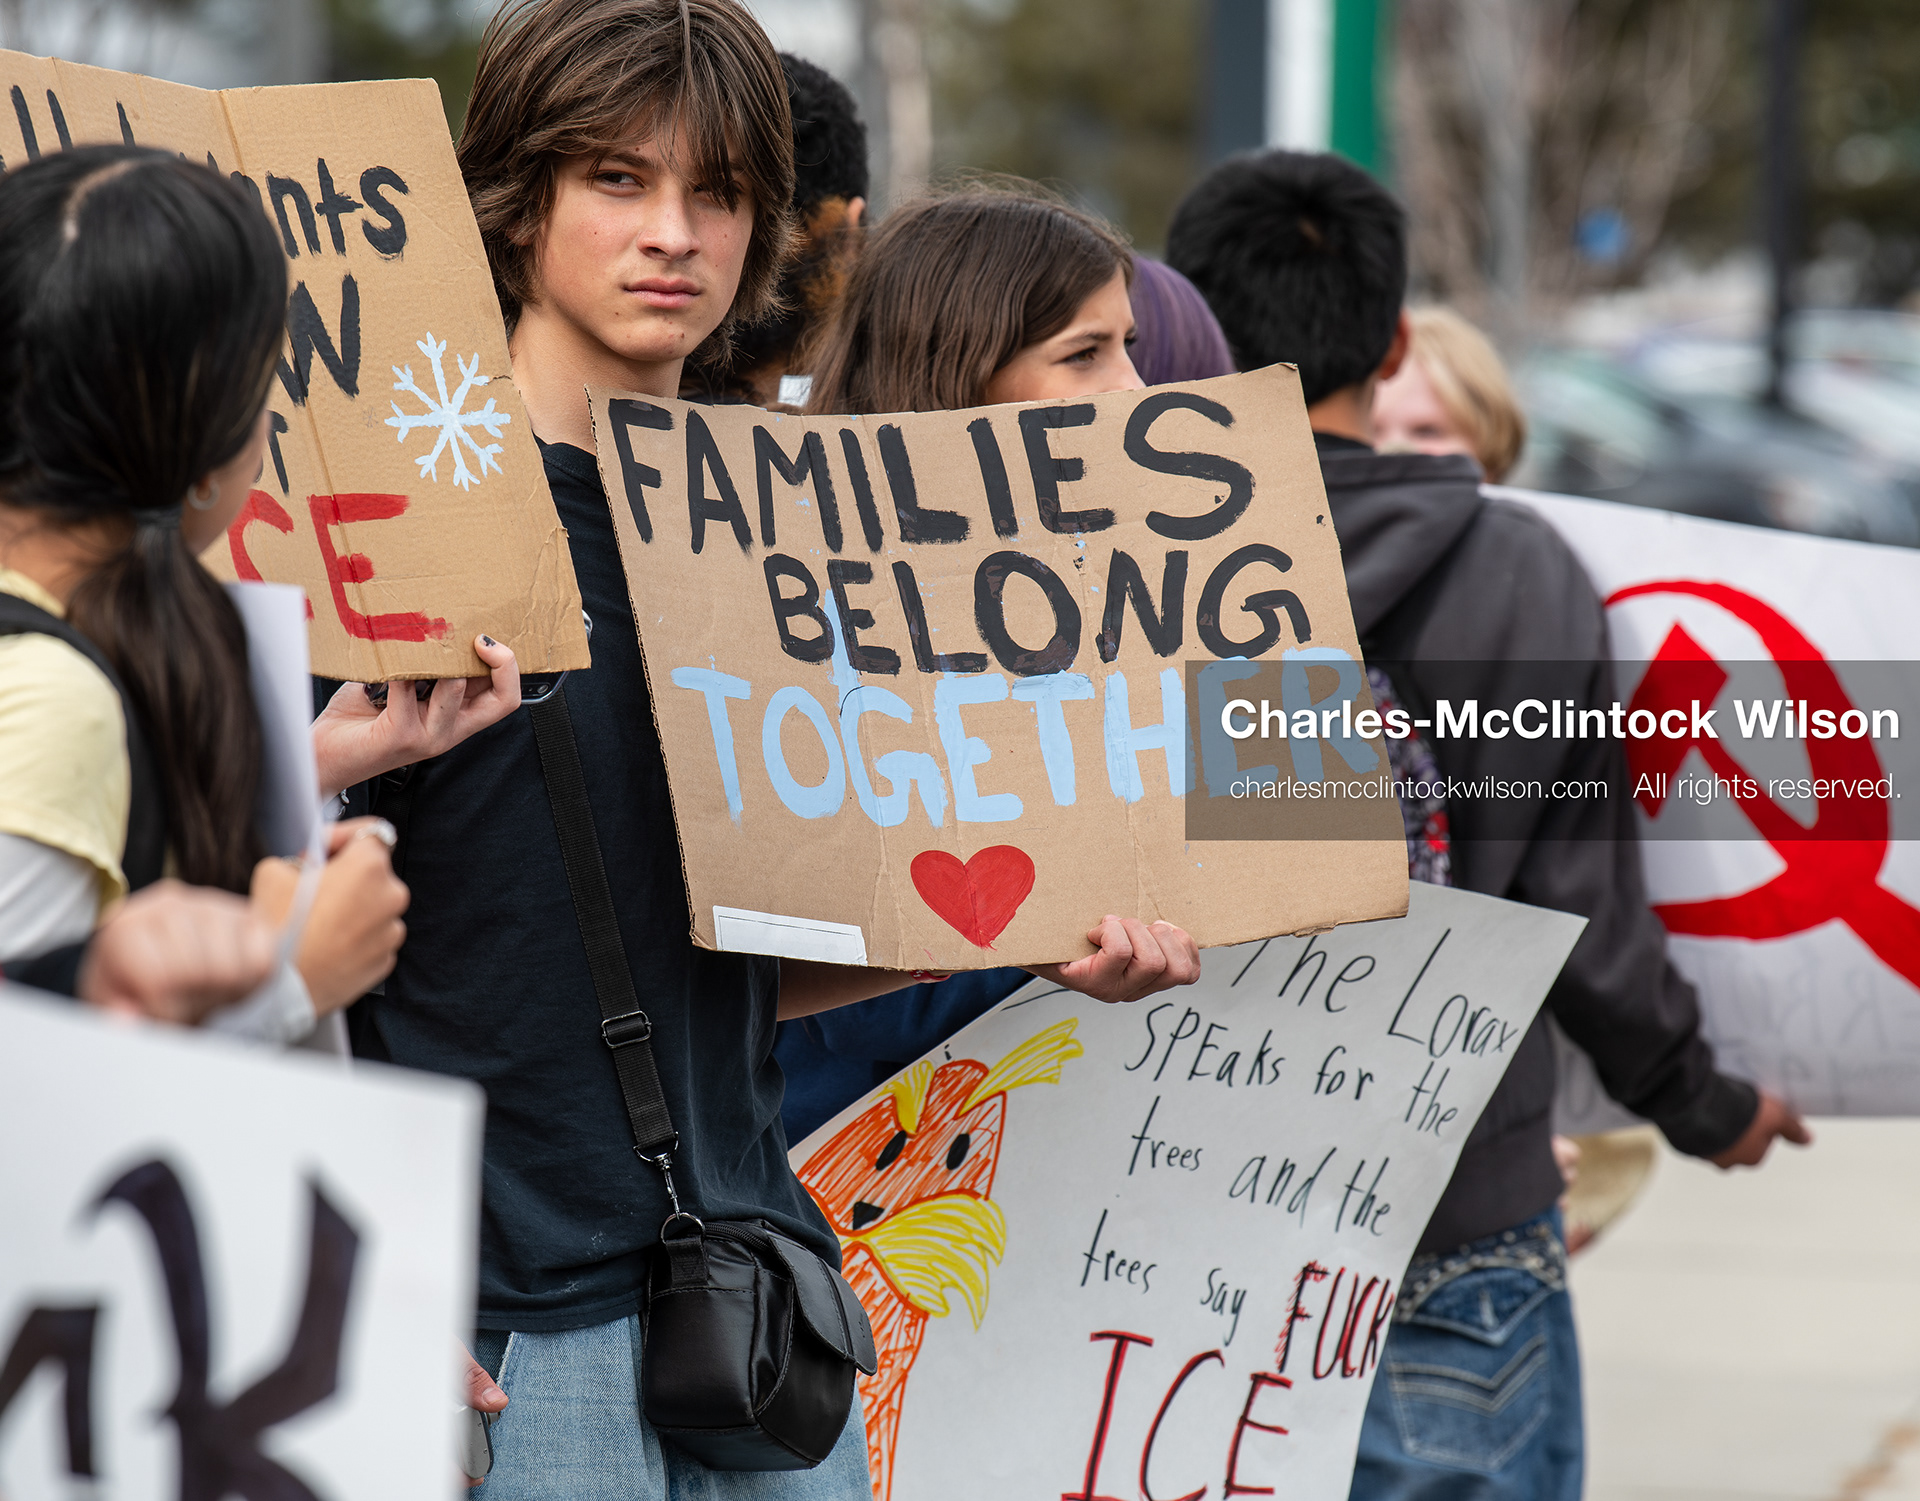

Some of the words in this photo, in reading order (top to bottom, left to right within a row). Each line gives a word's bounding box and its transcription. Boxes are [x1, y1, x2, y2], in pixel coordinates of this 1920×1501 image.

[608, 391, 1256, 555] FAMILIES
[228, 488, 454, 642] CE
[764, 544, 1313, 677] BELONG
[671, 647, 1381, 830] TOGETHER
[1387, 928, 1518, 1057] Lorax
[1128, 1096, 1204, 1176] trees
[1229, 1147, 1337, 1229] and
[1336, 1157, 1391, 1236] the
[1313, 1046, 1374, 1100] for
[1405, 1062, 1459, 1136] the
[1080, 1209, 1157, 1294] trees
[1200, 1268, 1247, 1347] say
[1275, 1260, 1395, 1380] FUCK
[1060, 1330, 1293, 1501] ICE
